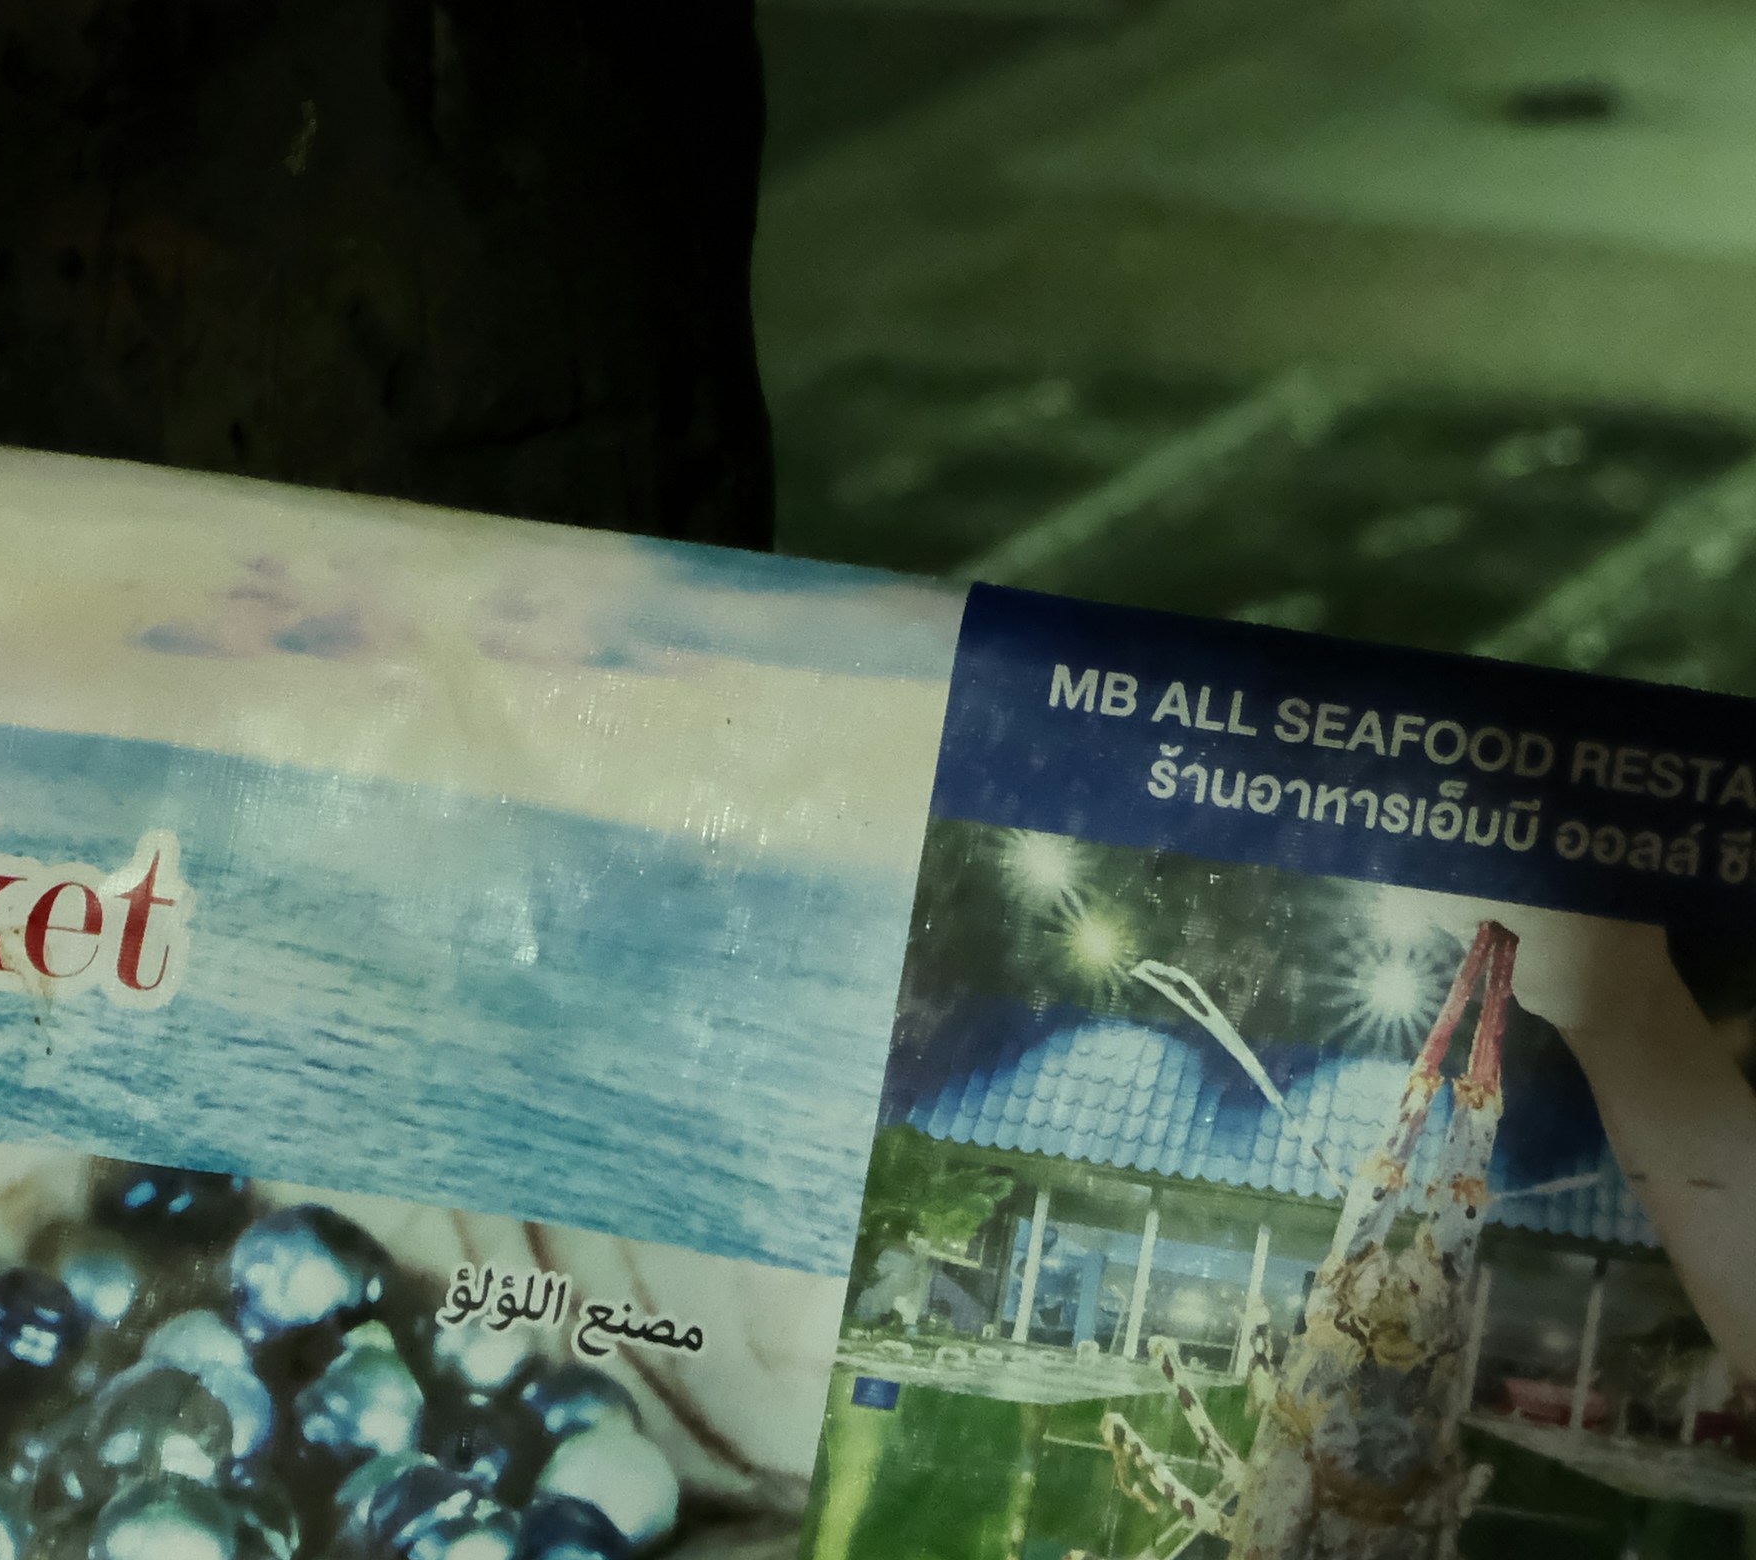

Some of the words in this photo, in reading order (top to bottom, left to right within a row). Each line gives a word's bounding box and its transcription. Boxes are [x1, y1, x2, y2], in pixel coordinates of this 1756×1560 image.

[1048, 663, 1139, 718] MB
[1150, 680, 1258, 737] ALL
[1273, 697, 1556, 778] SEAFOOD
[1569, 740, 1756, 812] RESTA
[1147, 742, 1541, 852] ร้านอาหารเอ็มบี
[442, 1265, 567, 1331] اللؤلؤ
[577, 1302, 704, 1356] مصنع
